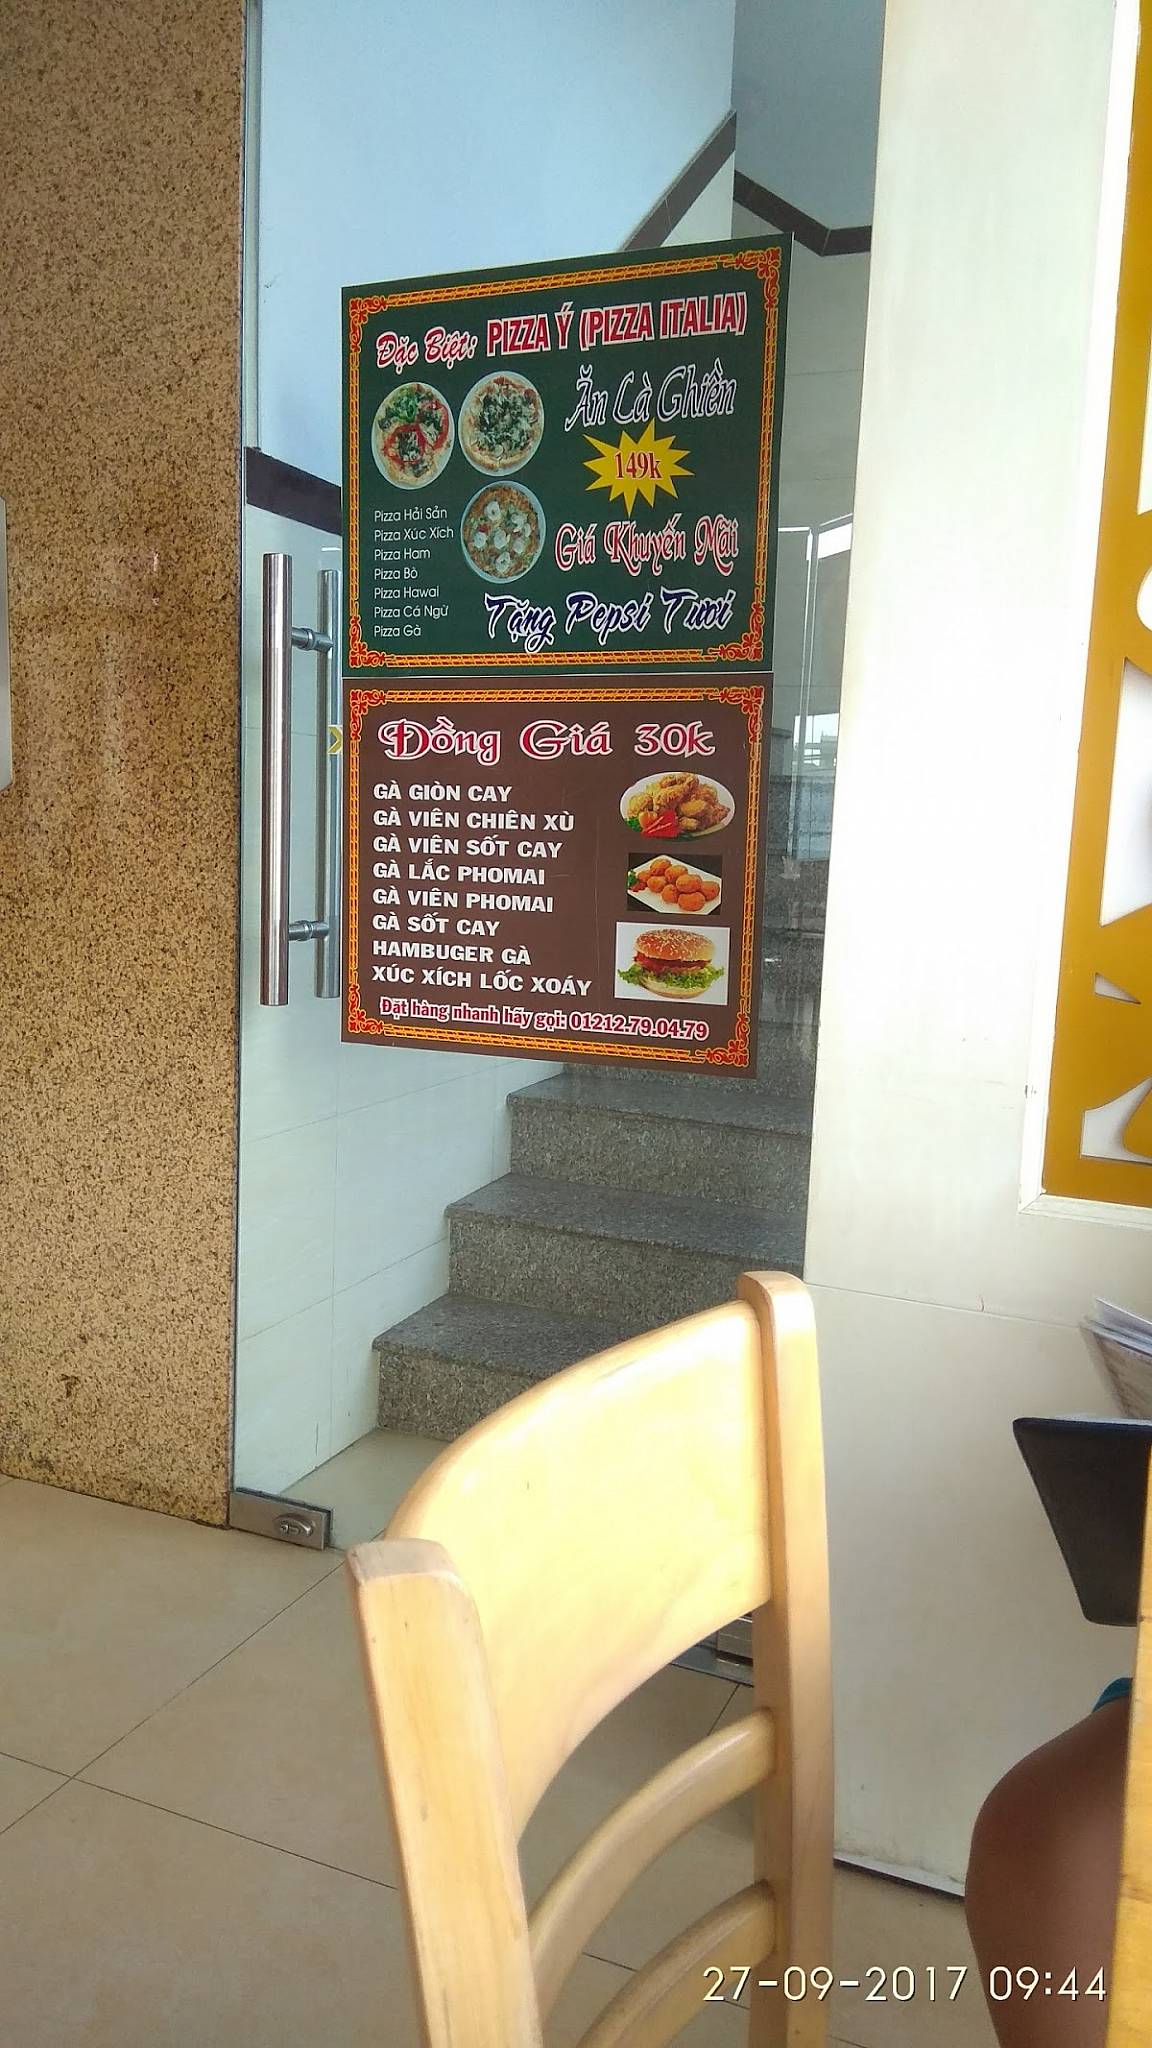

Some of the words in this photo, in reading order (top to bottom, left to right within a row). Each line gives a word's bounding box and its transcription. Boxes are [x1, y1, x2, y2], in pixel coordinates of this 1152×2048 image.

[376, 331, 419, 374] Đặc
[424, 326, 478, 369] Biệt:
[486, 314, 550, 357] PIZZA
[555, 301, 575, 350] Ý
[579, 303, 652, 350] (PIZZA
[659, 292, 748, 345] ITALIA)
[564, 364, 606, 432] Ăn
[612, 369, 650, 424] Cà
[656, 358, 738, 423] Ghiền
[614, 451, 662, 480] 149k
[374, 510, 400, 522] Pizza
[404, 506, 422, 520] Hải
[426, 505, 448, 520] Sản
[374, 530, 400, 542] Pizza
[404, 528, 426, 540] Xúc
[429, 526, 454, 539] Xích
[556, 523, 598, 572] Giá
[604, 513, 686, 576] Khuyến
[694, 514, 738, 576] Mãi
[374, 549, 400, 560] Pizza
[404, 548, 430, 560] Ham
[374, 568, 400, 580] Pizza
[404, 566, 418, 579] Bò
[374, 587, 400, 599] Pizza
[404, 586, 439, 598] Hawai
[374, 606, 400, 618] Pizza
[403, 605, 420, 617] Cá
[424, 604, 449, 620] Ngừ
[484, 593, 556, 654] Tặng
[566, 592, 654, 646] Pepsi
[660, 586, 736, 634] Tươi
[374, 626, 400, 637] Pizza
[403, 624, 421, 636] Gà
[378, 716, 501, 766] Đồng
[519, 718, 613, 760] Giá
[634, 718, 716, 759] 30k
[373, 780, 401, 800] GÀ
[409, 781, 461, 801] GIÒN
[467, 785, 512, 802] CAY
[373, 806, 401, 826] GÀ
[408, 808, 459, 828] VIÊN
[466, 810, 536, 830] CHIÊN
[543, 811, 574, 832] XÙ
[373, 833, 401, 853] GÀ
[408, 834, 459, 855] VIÊN
[466, 835, 509, 857] SỐT
[517, 841, 563, 858] CAY
[373, 859, 401, 879] GÀ
[408, 859, 450, 881] LẮC
[457, 866, 545, 885] PHOMAI
[373, 886, 401, 905] GÀ
[407, 888, 458, 908] VIÊN
[466, 893, 553, 913] PHOMAI
[373, 912, 400, 931] GÀ
[407, 912, 449, 934] SỐT
[456, 919, 500, 937] CAY
[373, 940, 493, 963] HAMBUGER
[501, 946, 531, 966] GÀ
[372, 964, 415, 984] XÚC
[421, 966, 472, 988] XÍCH
[480, 970, 523, 991] LỐC
[531, 975, 592, 996] XOÁY
[380, 996, 408, 1020] Đạt
[410, 1000, 450, 1022] hàng
[452, 1002, 500, 1024] nhanh
[502, 1006, 532, 1029] hãy
[534, 1010, 566, 1032] gọi:
[570, 1016, 710, 1041] 01212.79.04.79
